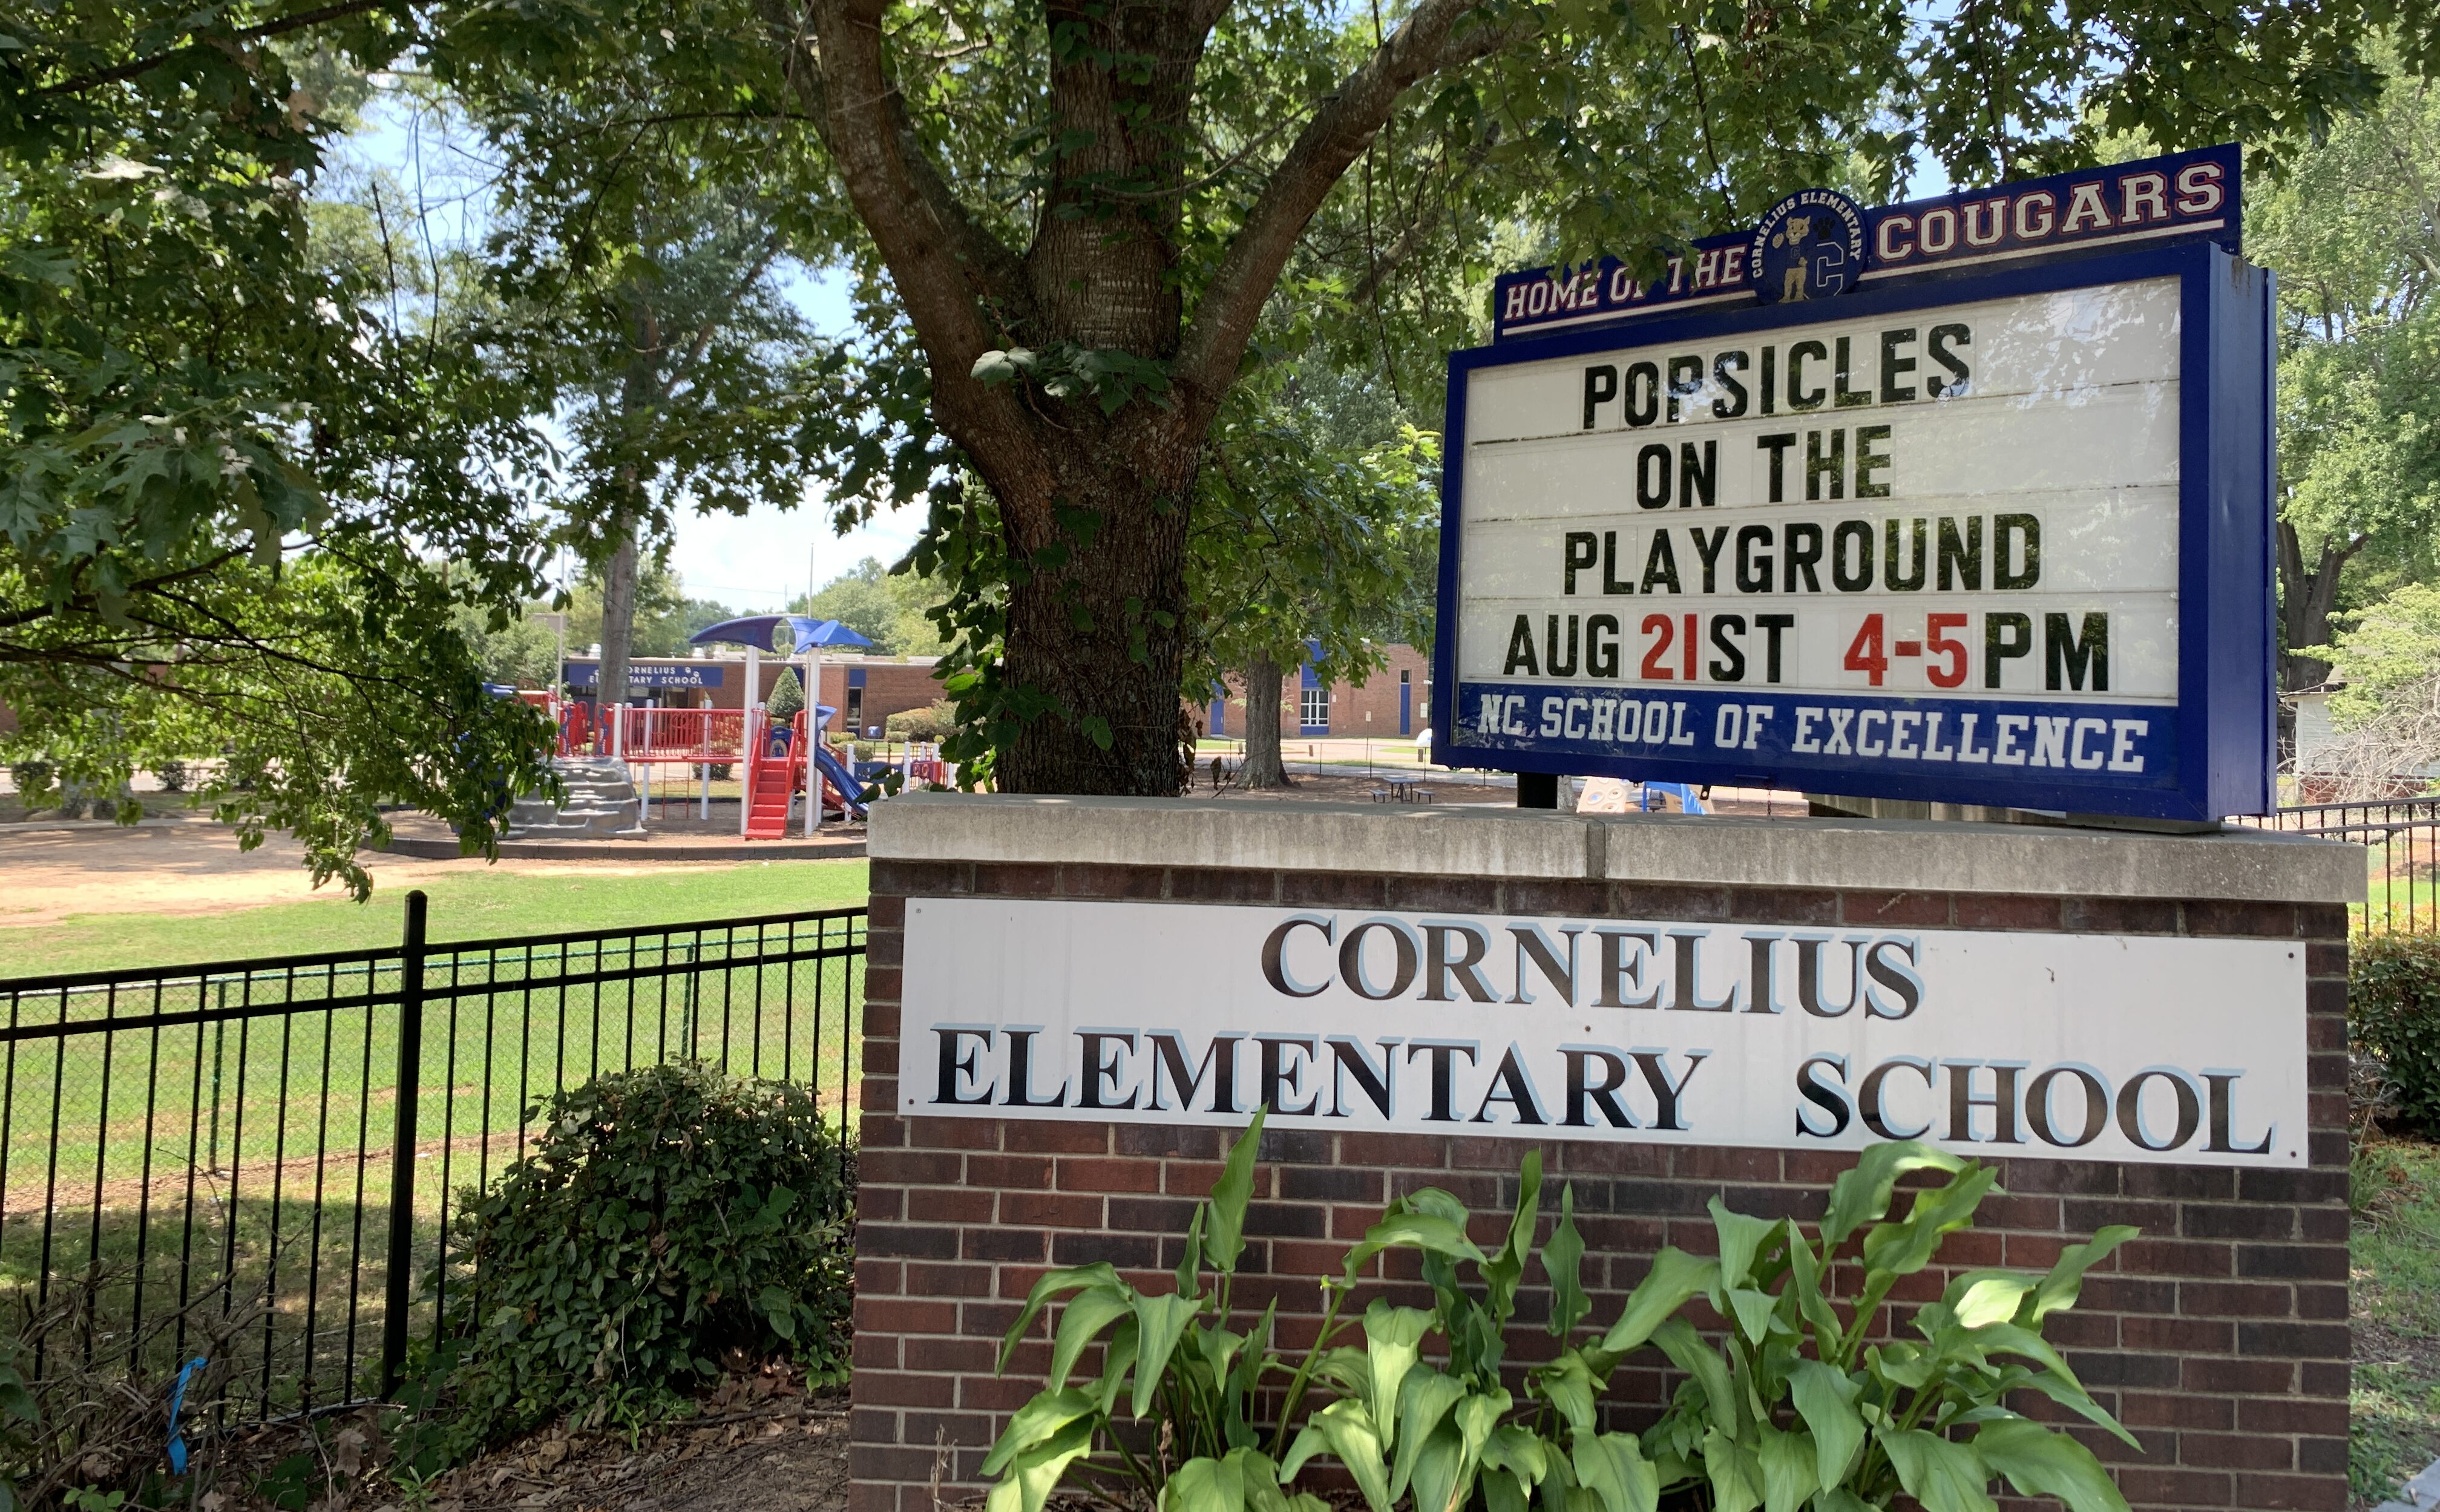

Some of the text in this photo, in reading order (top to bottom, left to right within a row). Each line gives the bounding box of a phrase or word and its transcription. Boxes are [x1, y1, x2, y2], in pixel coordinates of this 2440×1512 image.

[1503, 270, 1602, 321] HOME
[1666, 244, 1748, 295] THE
[1877, 162, 2225, 262] COUGARS
[1751, 191, 1862, 278] CORNELIUS ELEMENTARY
[1582, 322, 1972, 430] POPSICLES
[1636, 425, 1892, 509] ON THE
[1564, 513, 2041, 595] PLAYGROUND
[589, 675, 653, 684] ELTARY
[628, 666, 676, 675] ORNELIUS
[1503, 614, 1619, 678] AUG
[1477, 694, 2149, 773] NC SCHOOL OF EXCELLENCE
[1261, 912, 1926, 1021] CORNELIUS
[928, 1022, 2277, 1154] ELEMENTARY SCHOOL
